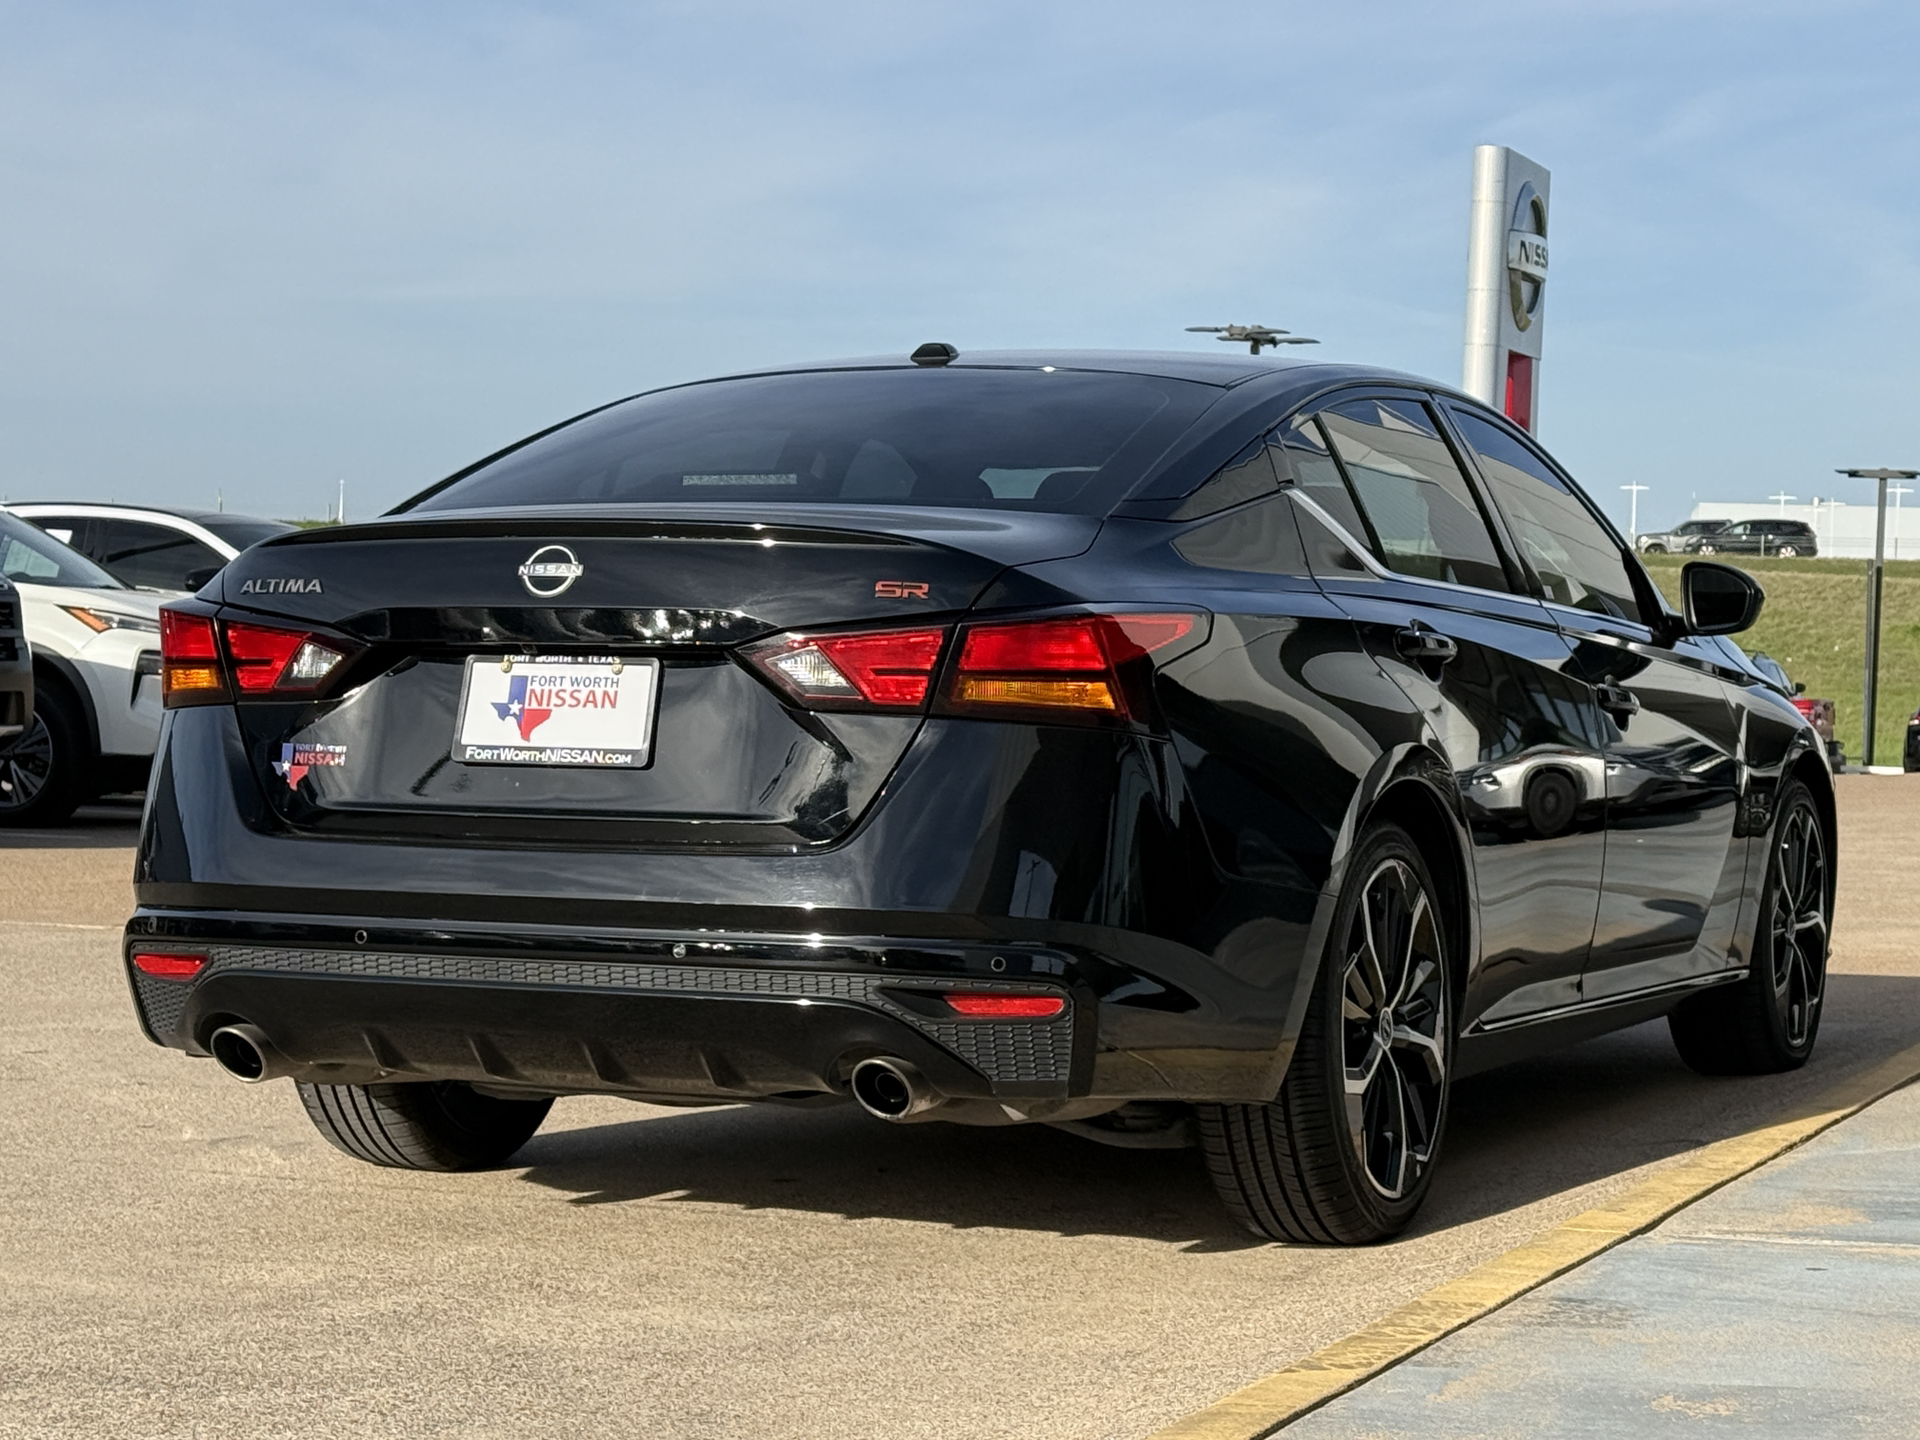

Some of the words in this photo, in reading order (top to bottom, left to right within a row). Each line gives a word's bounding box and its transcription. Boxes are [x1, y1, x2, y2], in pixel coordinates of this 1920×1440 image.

[1519, 240, 1548, 270] NISS
[519, 564, 582, 575] NISSAN
[239, 578, 323, 594] ALTIMA
[874, 580, 929, 599] SR
[588, 655, 621, 664] TEXAS
[529, 675, 566, 688] FORT
[569, 675, 620, 689] WORTH
[527, 688, 619, 709] NISSAN
